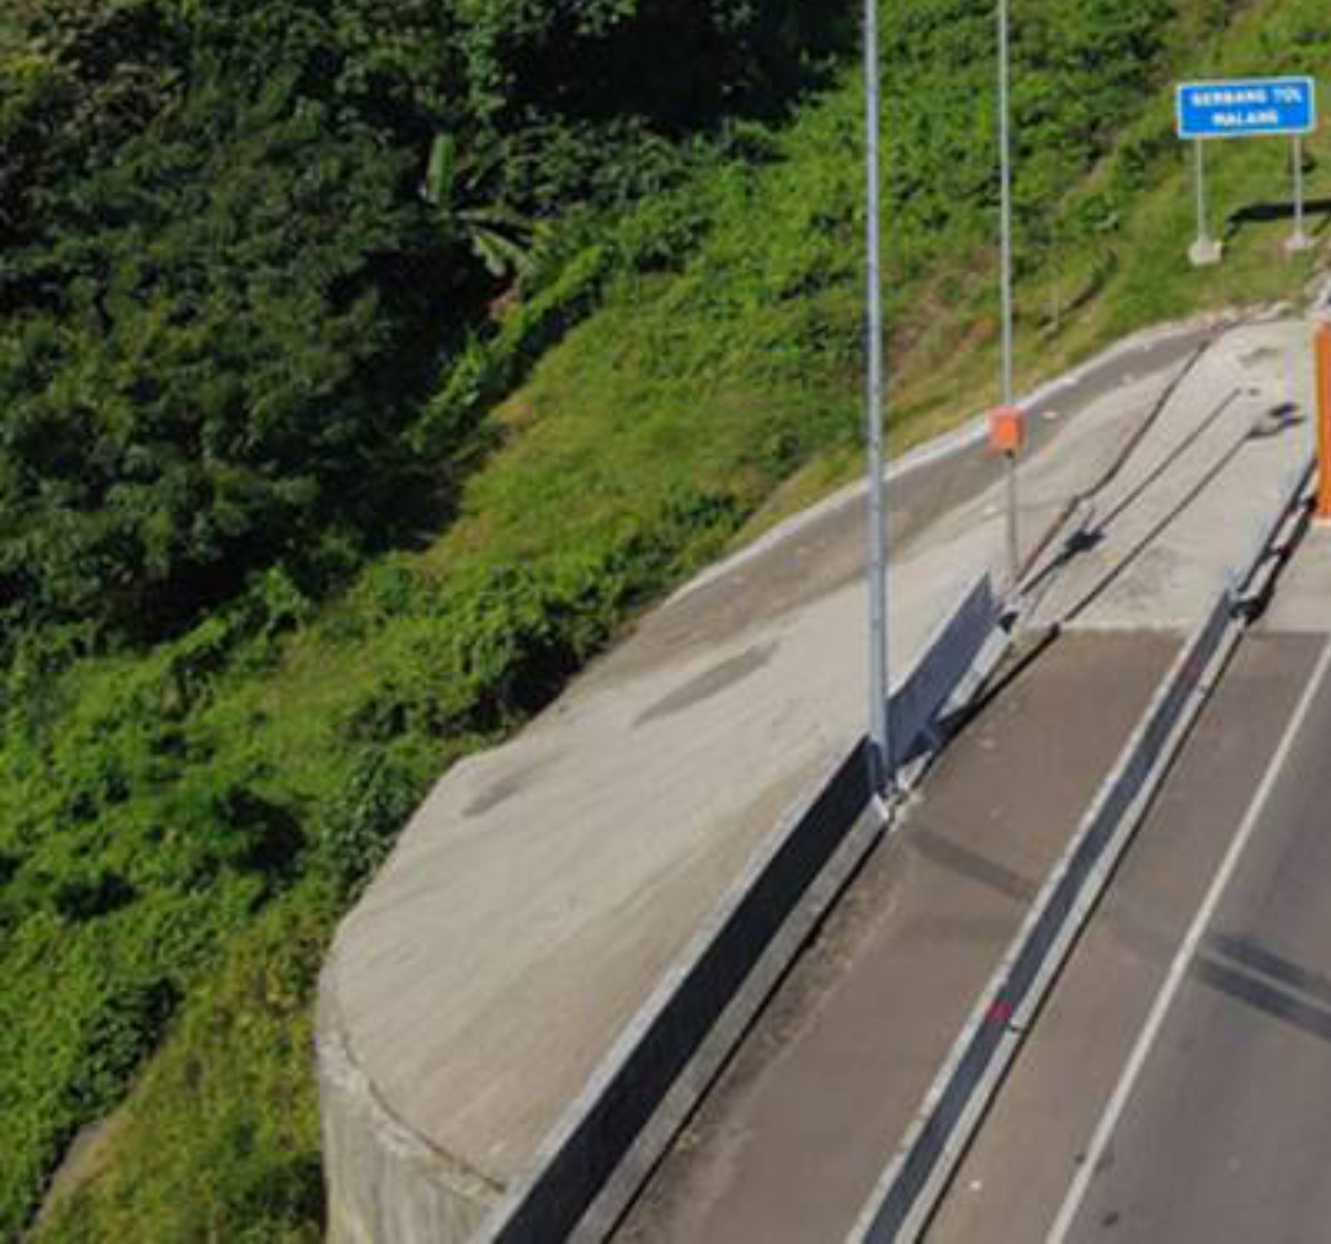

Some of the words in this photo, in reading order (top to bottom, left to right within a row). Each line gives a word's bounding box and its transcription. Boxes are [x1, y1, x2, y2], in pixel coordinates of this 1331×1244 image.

[1191, 90, 1267, 107] GERBANG
[1273, 86, 1302, 103] TOL
[1213, 110, 1278, 126] MALANG
